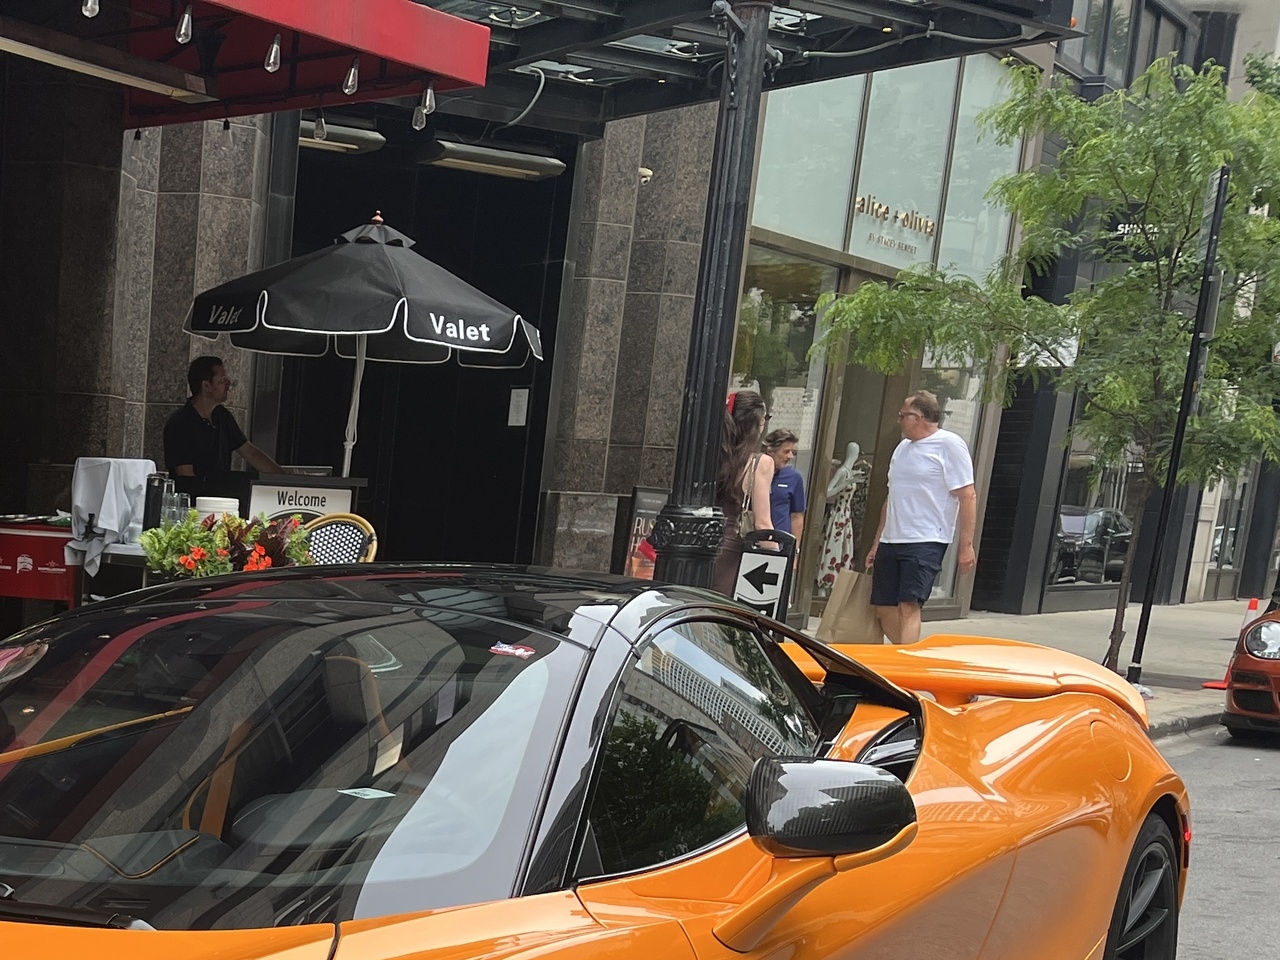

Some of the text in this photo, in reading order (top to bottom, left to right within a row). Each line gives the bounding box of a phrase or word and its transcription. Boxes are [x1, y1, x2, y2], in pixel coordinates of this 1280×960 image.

[856, 194, 889, 221] alice
[901, 209, 935, 237] olivia
[209, 304, 243, 325] Valet
[429, 312, 491, 342] Valet
[277, 490, 327, 507] Welcome
